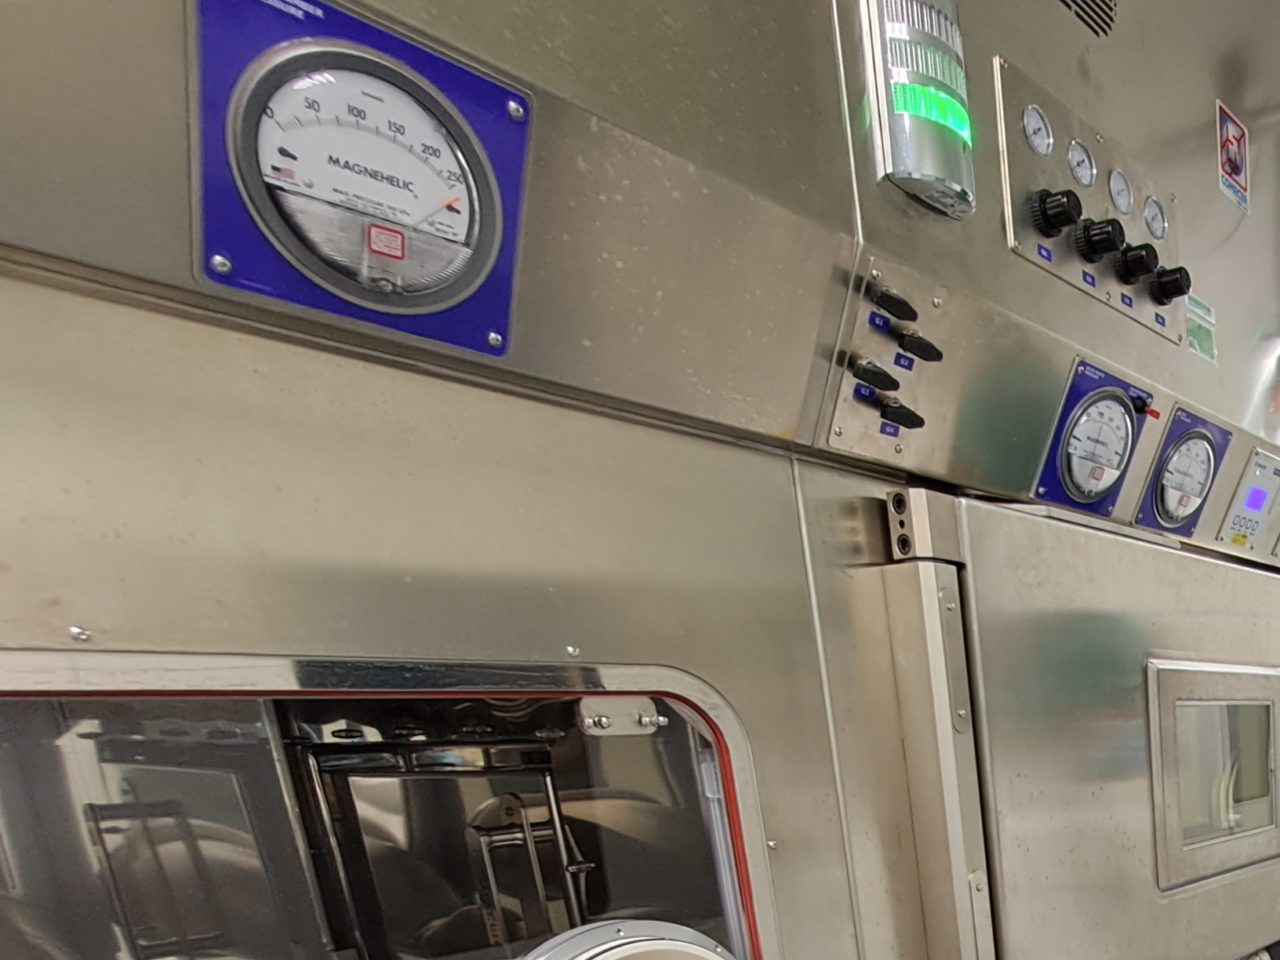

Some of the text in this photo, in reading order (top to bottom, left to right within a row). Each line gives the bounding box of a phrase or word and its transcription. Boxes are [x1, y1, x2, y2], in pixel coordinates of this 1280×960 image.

[304, 97, 320, 113] 50
[346, 103, 367, 121] 100
[388, 119, 405, 136] 150
[421, 143, 441, 159] 200
[328, 154, 415, 194] MAGNEHELIC
